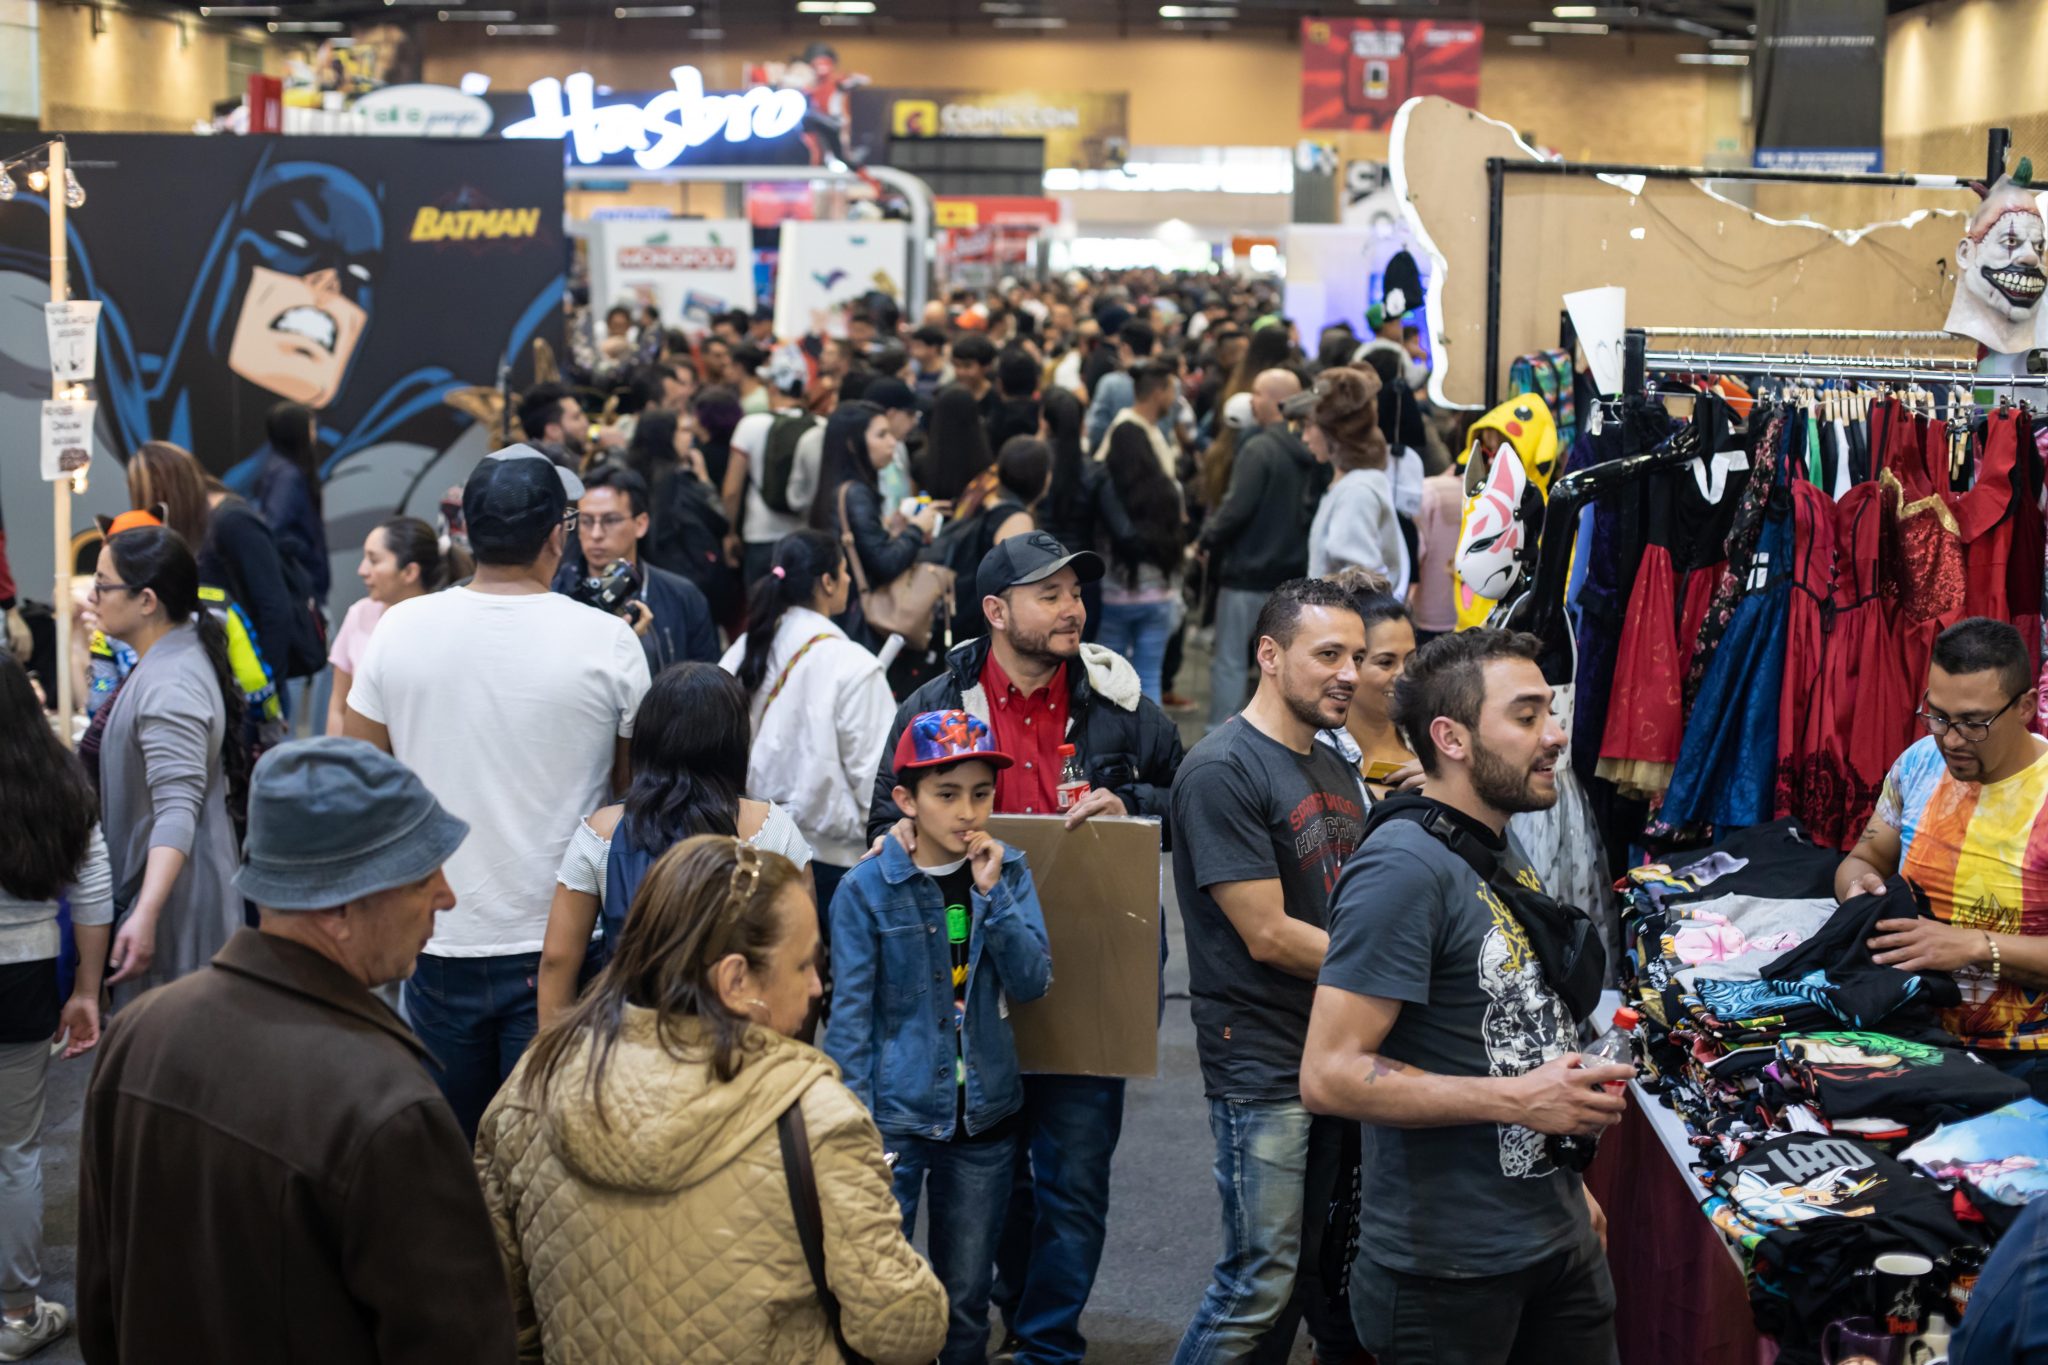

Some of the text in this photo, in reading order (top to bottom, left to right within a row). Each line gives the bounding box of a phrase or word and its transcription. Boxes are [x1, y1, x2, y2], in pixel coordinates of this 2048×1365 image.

[501, 65, 807, 170] Hasbro
[410, 206, 541, 242] BATMAN
[619, 248, 735, 271] MONOPOLY
